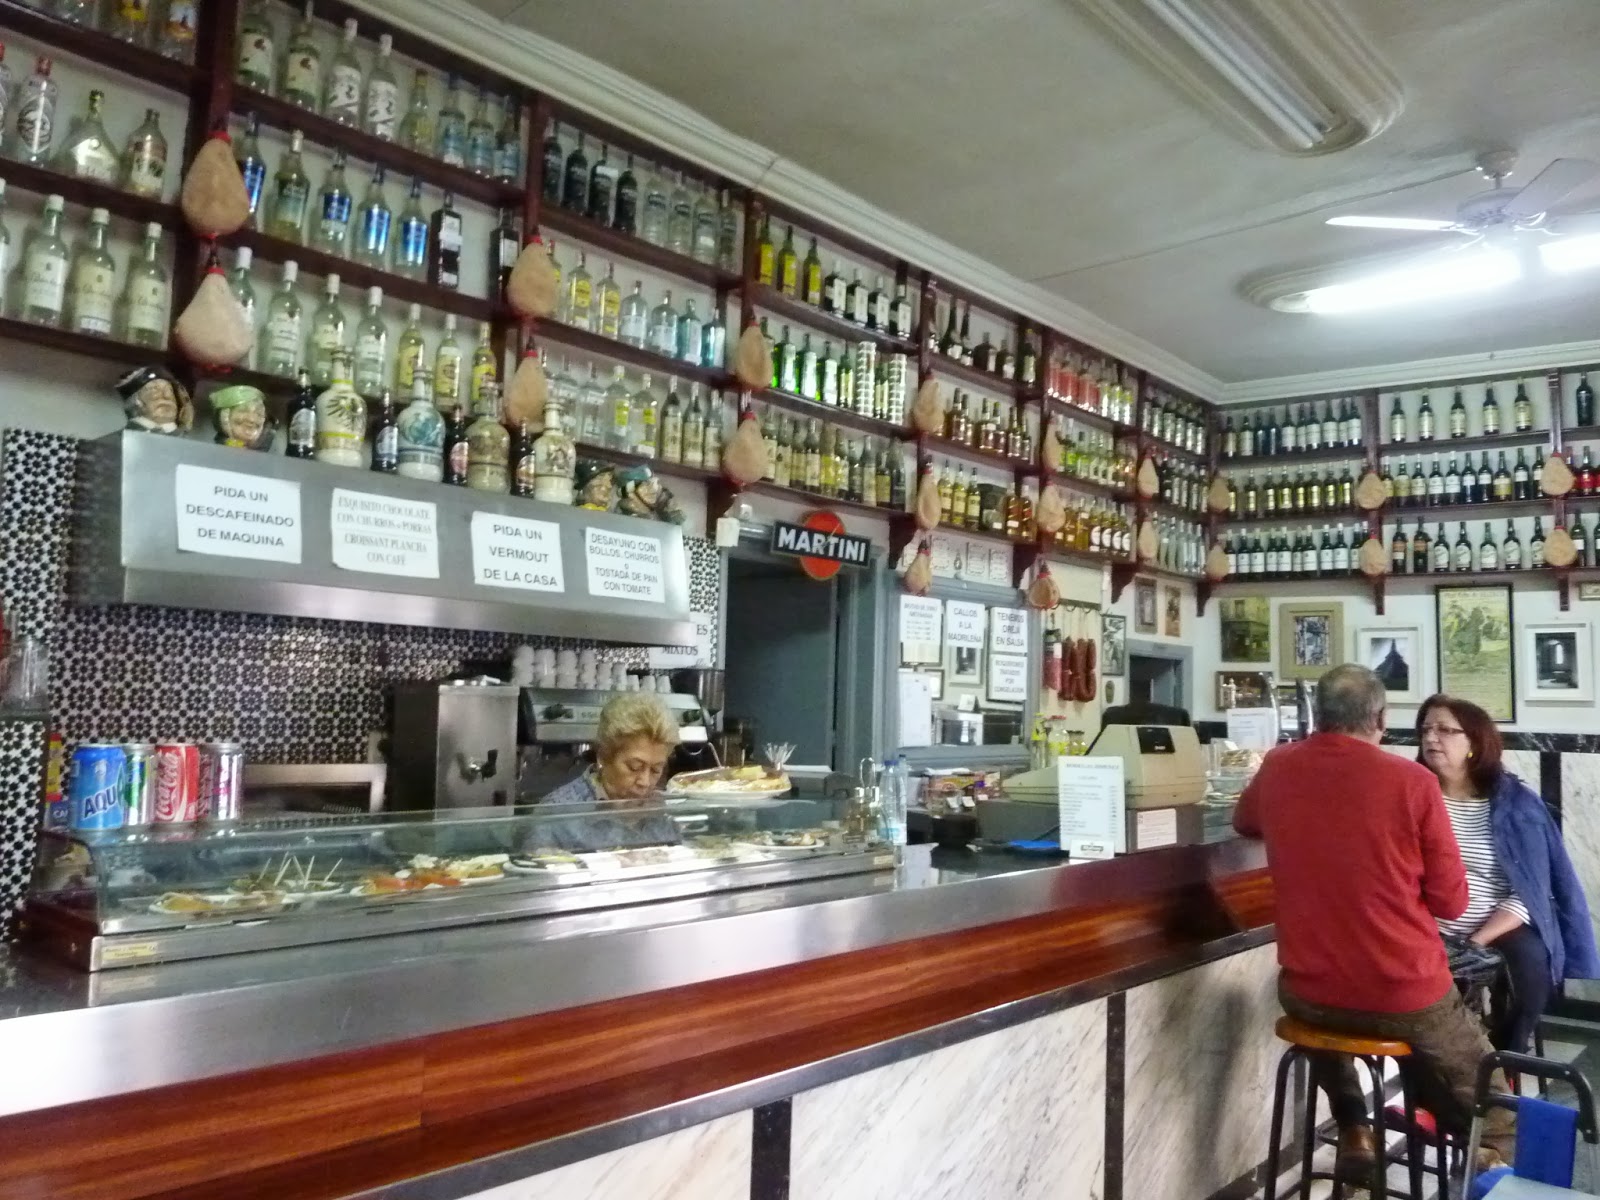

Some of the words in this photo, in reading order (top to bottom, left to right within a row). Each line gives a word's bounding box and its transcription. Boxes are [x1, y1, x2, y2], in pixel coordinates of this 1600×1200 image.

[213, 485, 245, 499] PIDA
[249, 492, 268, 502] UN
[186, 503, 294, 527] DESCAFEINADO
[383, 502, 430, 520] CHOCOLATE
[337, 512, 354, 525] CON
[356, 515, 395, 530] CHURROS
[197, 528, 217, 540] DE
[220, 530, 284, 547] MAQUINA
[493, 524, 522, 538] PIDA
[525, 529, 542, 541] UN
[344, 533, 390, 550] CROISSANT
[391, 539, 427, 553] PLANCHA
[591, 533, 636, 551] DESAYUNO
[638, 541, 657, 553] CON
[777, 526, 866, 562] MARTINI
[367, 552, 382, 564] CON
[489, 546, 549, 563] VERMOUT
[624, 550, 659, 564] CHURROS
[484, 568, 501, 580] DE
[505, 571, 521, 583] LA
[524, 573, 558, 587] CASA
[595, 567, 630, 580] TOSTADA
[632, 572, 643, 581] DE
[644, 574, 658, 584] PAN
[604, 581, 621, 592] CON
[622, 583, 652, 595] TOMATE
[953, 607, 978, 618] CALLOS
[1006, 638, 1024, 647] SALSA
